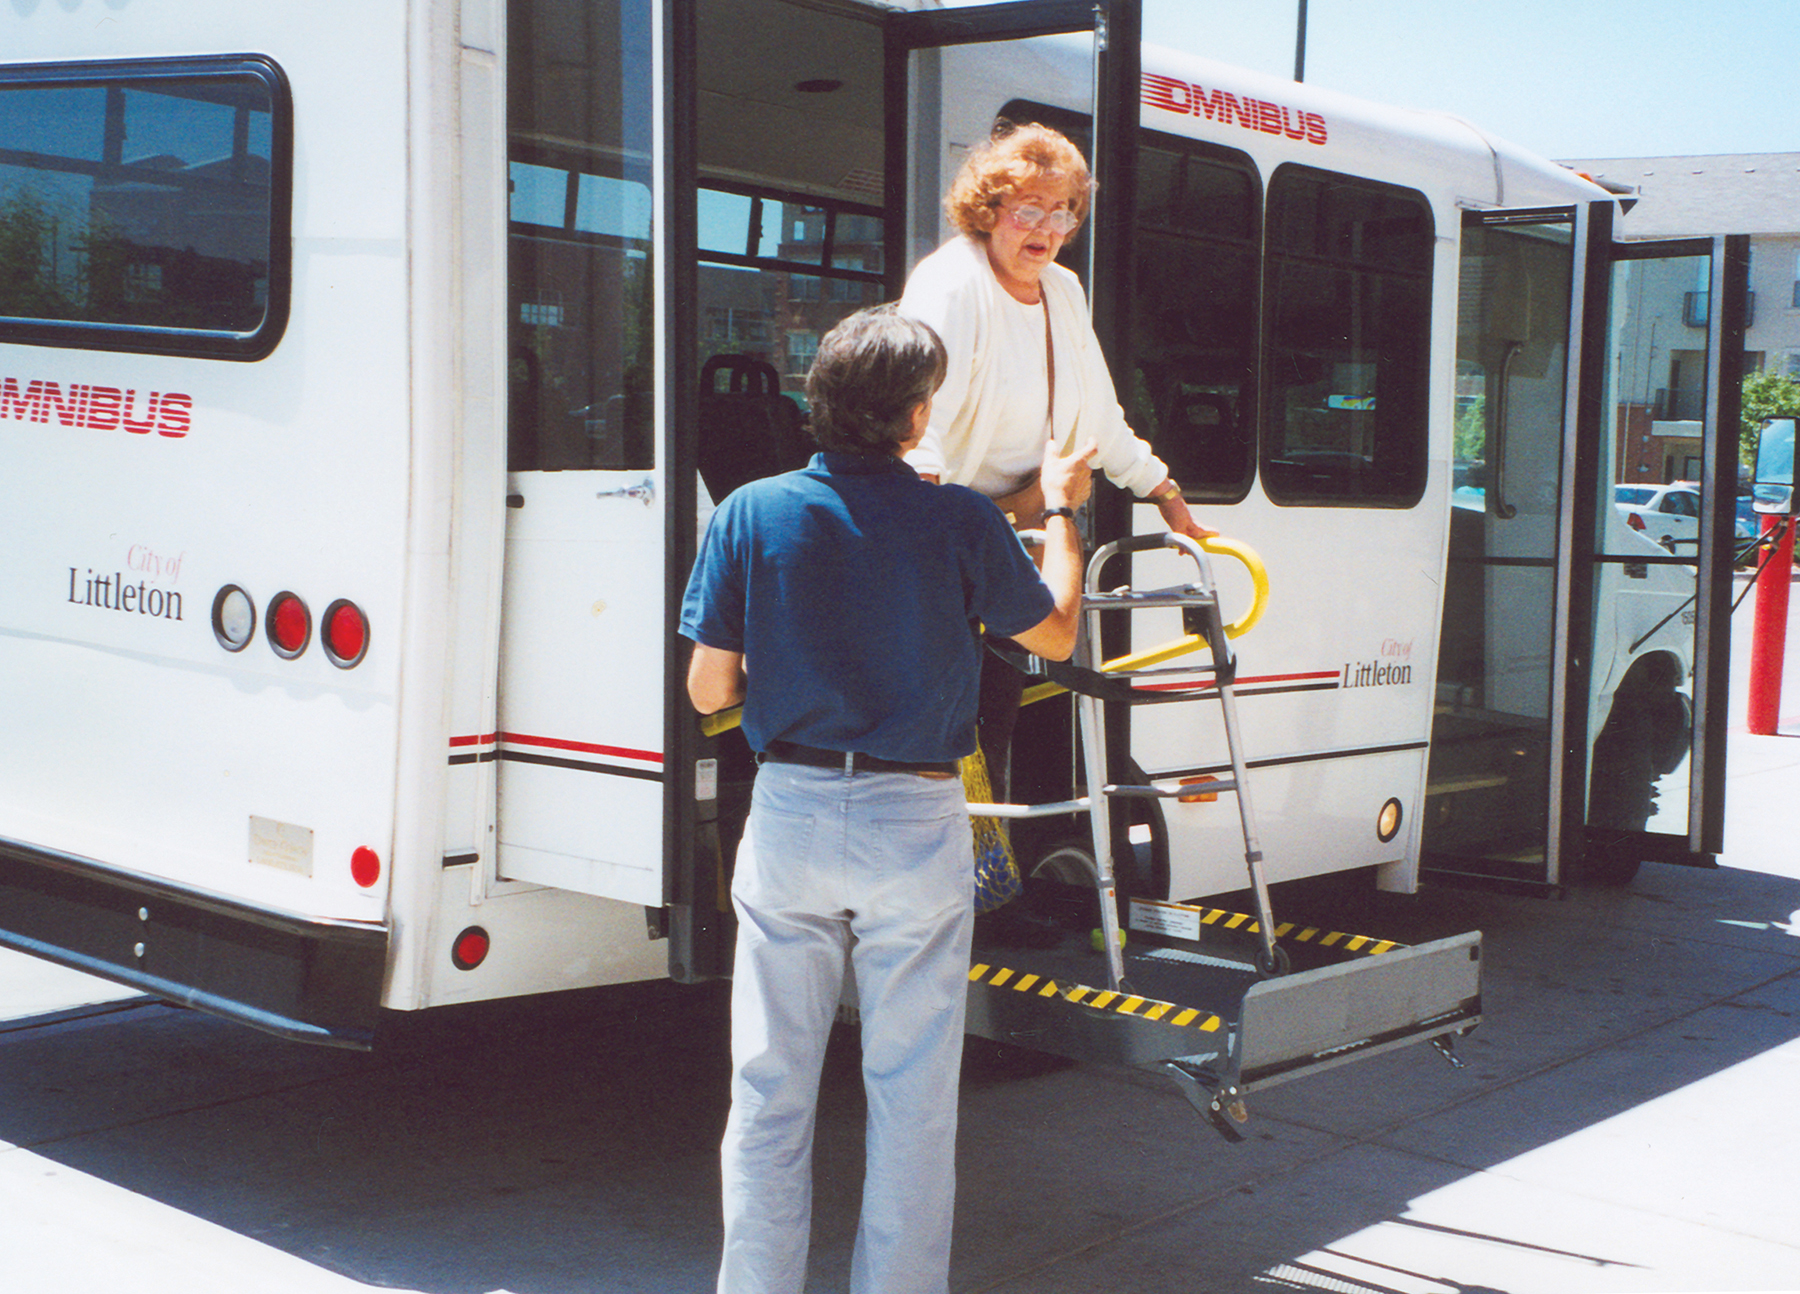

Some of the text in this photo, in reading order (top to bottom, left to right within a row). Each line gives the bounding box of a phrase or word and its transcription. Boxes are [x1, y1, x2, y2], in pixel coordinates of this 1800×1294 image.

[1140, 72, 1328, 146] OMNIBUS
[0, 377, 193, 438] MNIBUS
[127, 543, 187, 585] City of
[68, 566, 184, 622] Littleton
[1342, 659, 1412, 689] Littleton
